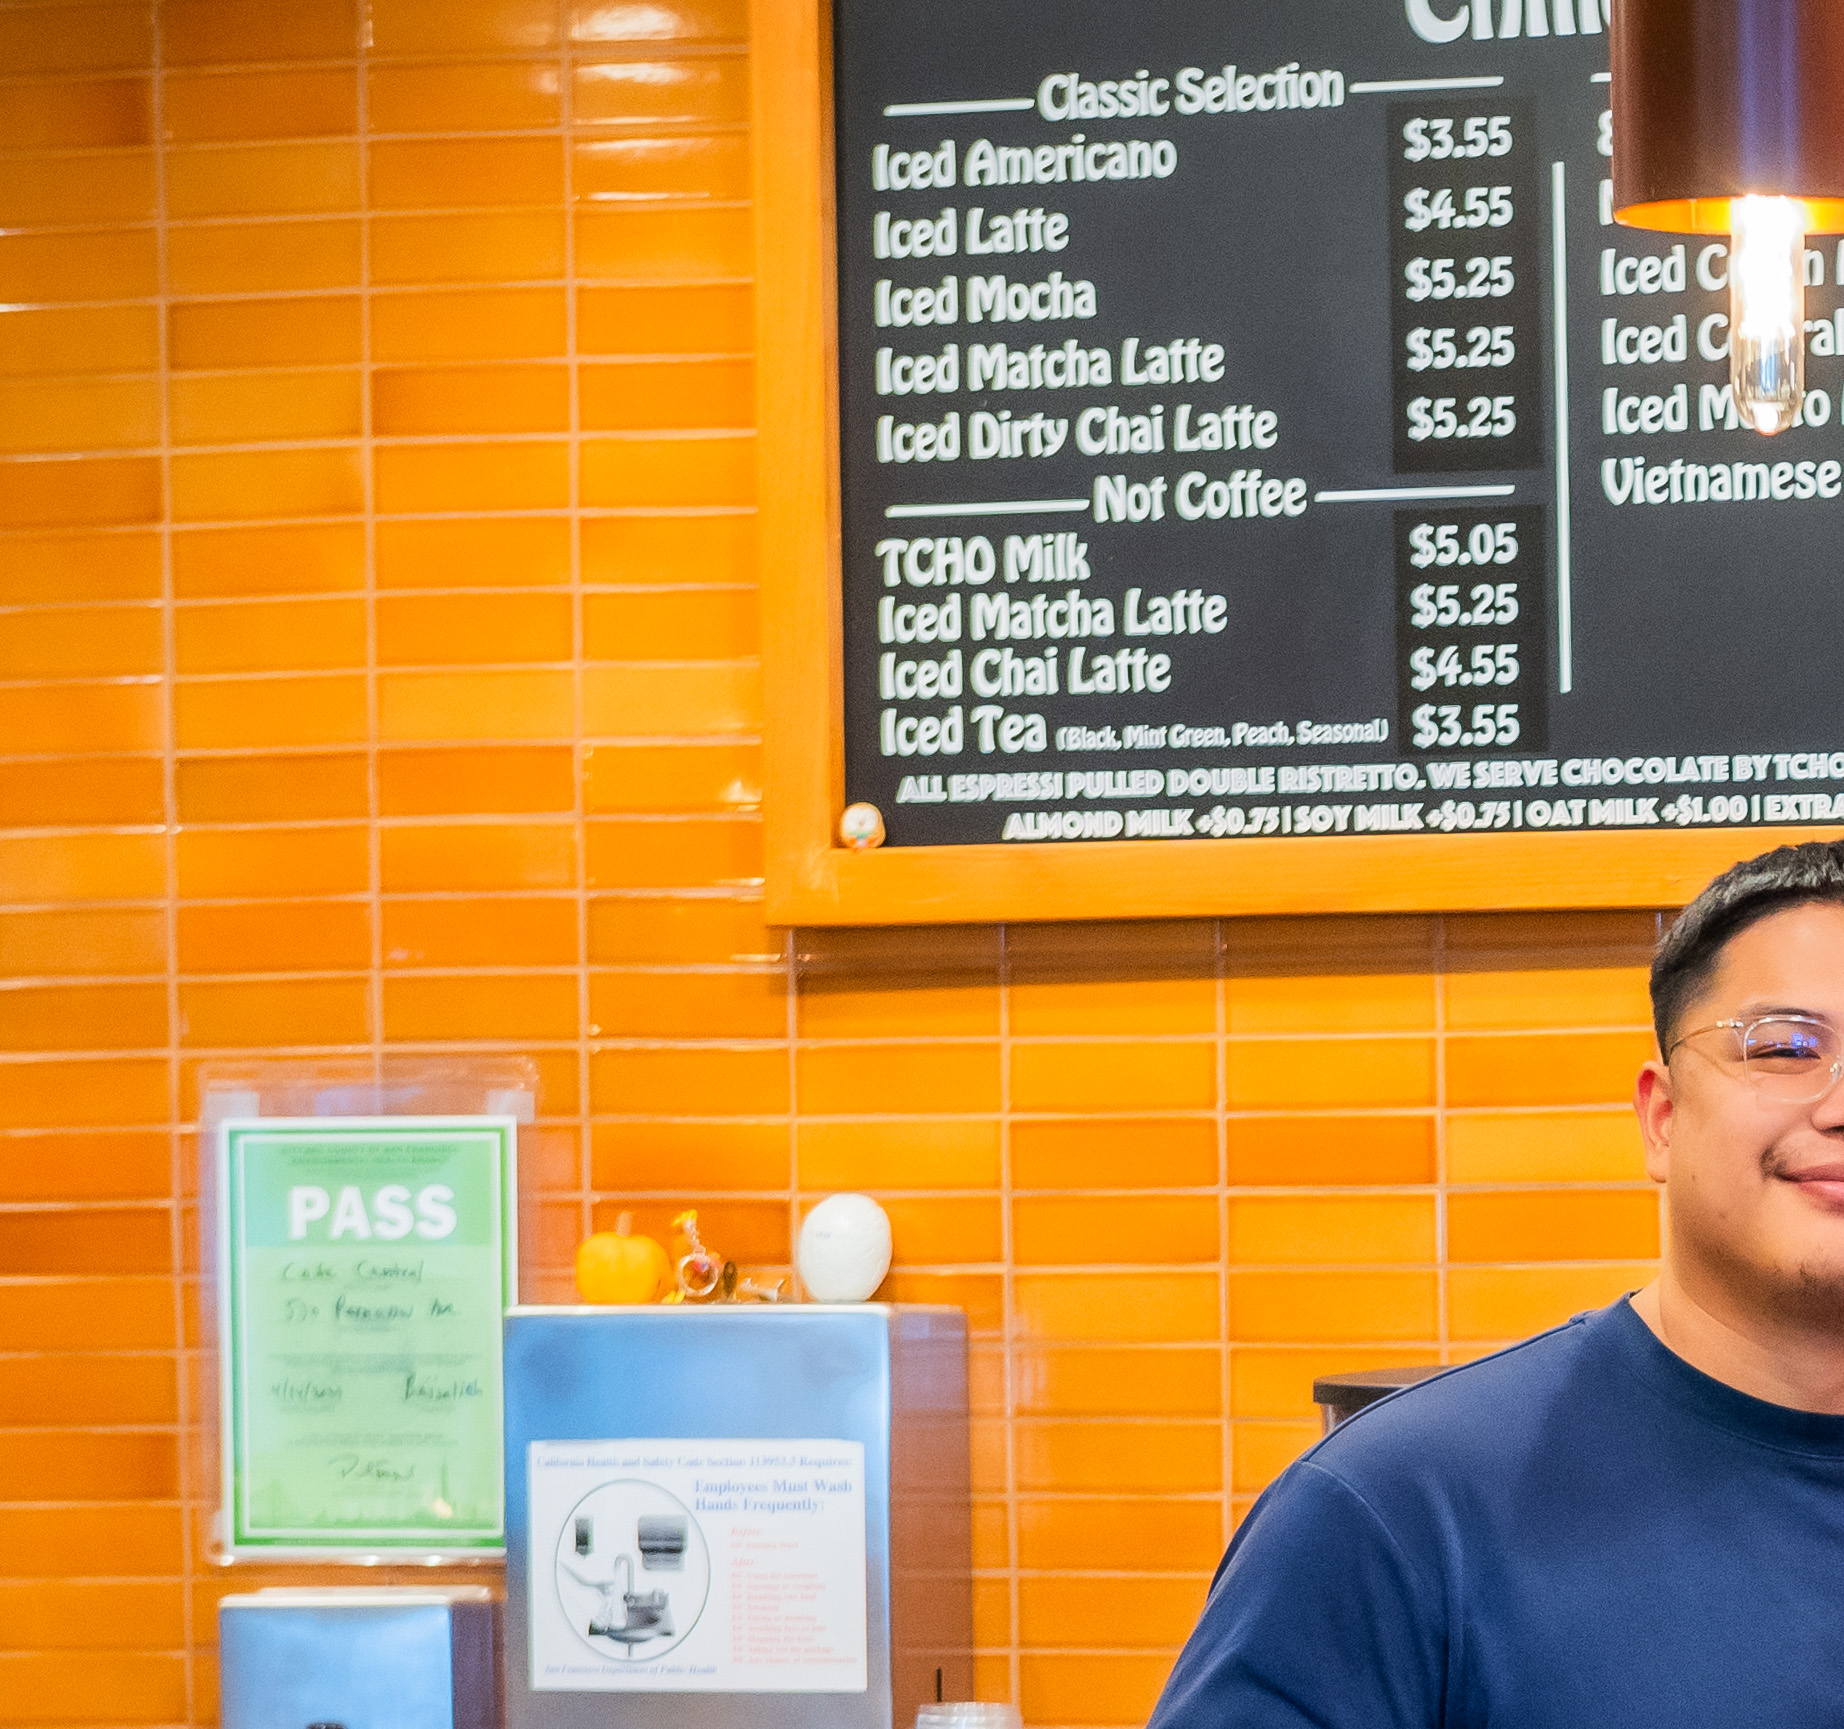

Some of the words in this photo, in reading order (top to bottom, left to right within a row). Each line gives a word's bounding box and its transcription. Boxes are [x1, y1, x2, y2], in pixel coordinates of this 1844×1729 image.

[1038, 69, 1170, 121] Classic
[1175, 62, 1345, 115] Selection
[874, 140, 956, 191] Iced
[965, 133, 1177, 187] Americano
[1404, 116, 1513, 162] $3.55
[875, 207, 957, 259] Iced
[966, 207, 1069, 255] Latte
[1404, 185, 1513, 232] $4.55
[1405, 256, 1514, 302] $5.25
[1600, 244, 1686, 296] Iced
[876, 275, 959, 327] Iced
[967, 271, 1097, 323] Mocha
[1406, 326, 1515, 372] $5.25
[1601, 313, 1687, 365] Iced
[877, 343, 959, 395] Iced
[968, 339, 1112, 391] Matcha
[1121, 337, 1225, 385] Latte
[878, 411, 961, 463] Iced
[969, 410, 1069, 460] Dirty
[1075, 404, 1165, 456] Chai
[1174, 404, 1278, 452] Latte
[1407, 396, 1516, 441] $5.25
[1603, 383, 1688, 435] Iced
[1094, 474, 1168, 523] Not
[1175, 468, 1307, 520] Coffee
[1602, 456, 1842, 506] Vietnamese
[876, 535, 996, 587] TCHO
[1004, 532, 1091, 583] Milk
[1410, 522, 1518, 568] $5.05
[880, 592, 962, 644] Iced
[970, 589, 1115, 641] Matcha
[1124, 588, 1228, 636] Latte
[1411, 583, 1519, 628] $5.25
[880, 649, 963, 700] Iced
[971, 646, 1059, 698] Chai
[1068, 646, 1172, 694] Latte
[1410, 644, 1519, 691] $4.55
[881, 705, 964, 756] Iced
[970, 704, 1047, 754] Tea
[1122, 724, 1168, 749] Mint
[1412, 703, 1520, 748] $3.55
[897, 775, 948, 803] ALL
[1065, 769, 1165, 799] PULLED
[1166, 766, 1275, 798] DOUBLE
[1426, 762, 1471, 789] WE
[1472, 759, 1558, 788] SERVE
[1561, 755, 1730, 786] CHOCOLATE
[1732, 754, 1772, 781] BY
[288, 1184, 457, 1240] PASS
[772, 1480, 808, 1493] Must
[813, 1479, 853, 1493] Wash
